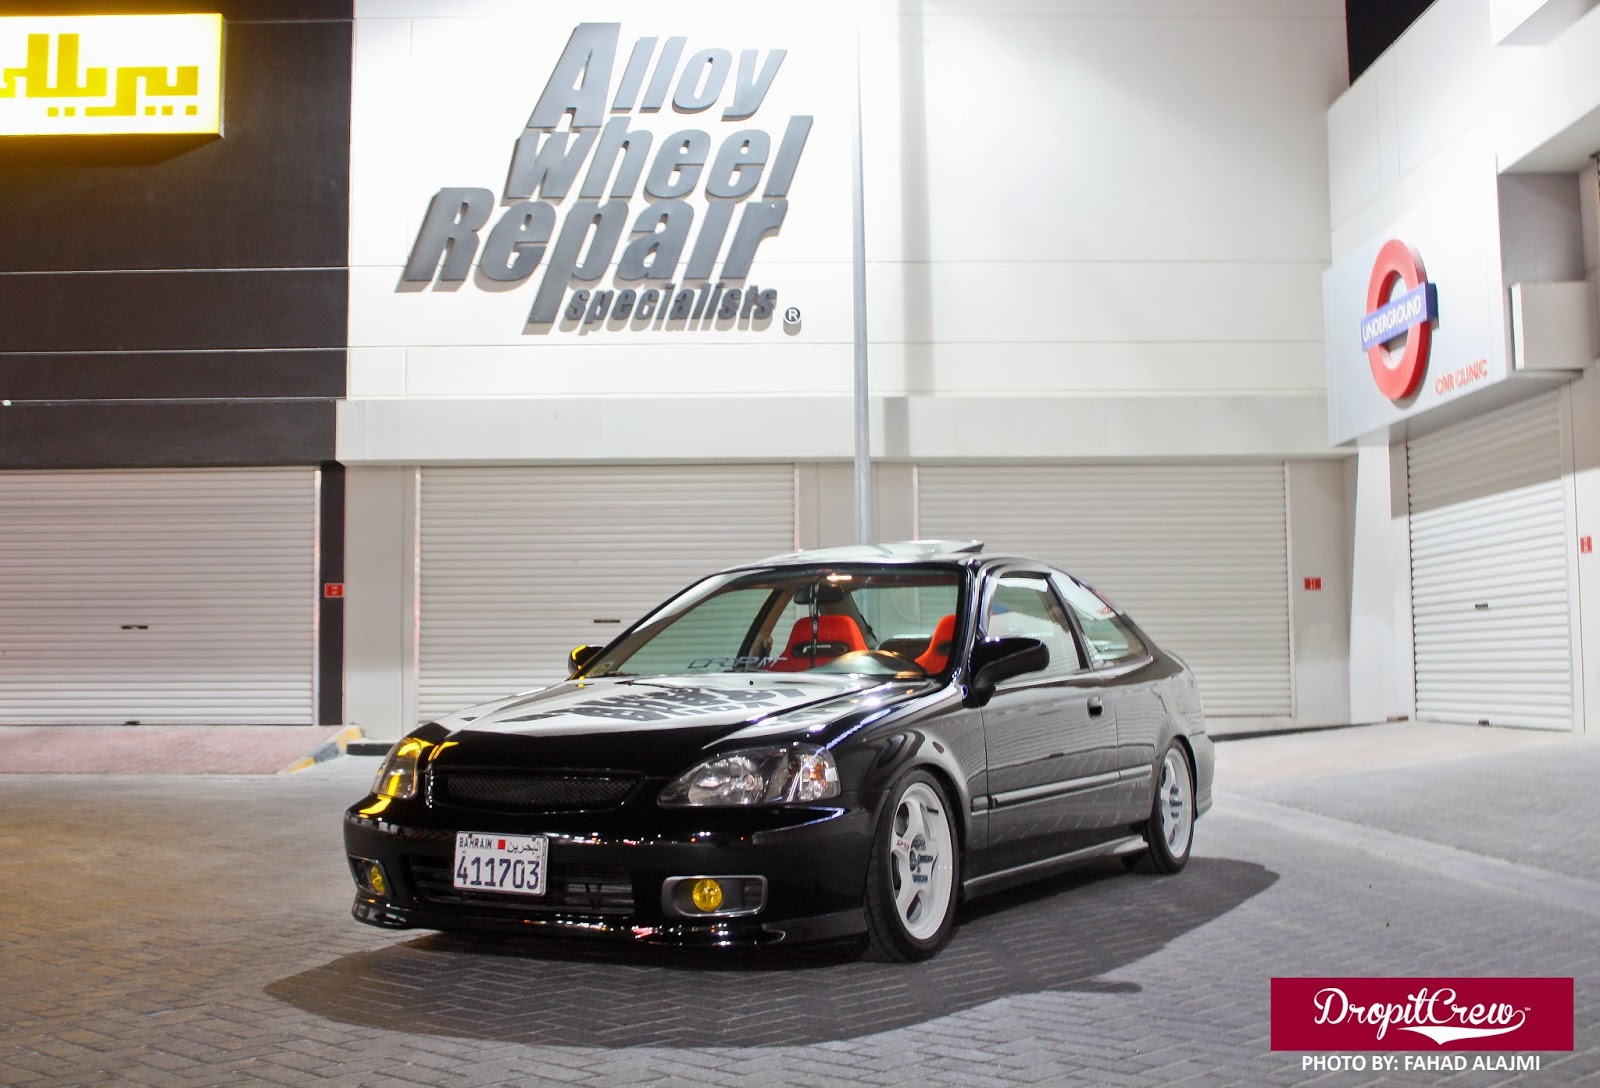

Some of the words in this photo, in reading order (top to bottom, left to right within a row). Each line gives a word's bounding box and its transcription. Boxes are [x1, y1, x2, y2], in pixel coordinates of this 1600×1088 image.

[525, 22, 788, 127] Alloy
[400, 187, 789, 326] Repair
[564, 282, 778, 326] specialists
[1362, 295, 1422, 342] UNDERGROUND
[459, 838, 493, 850] BAHRAIN
[456, 855, 540, 890] 411703
